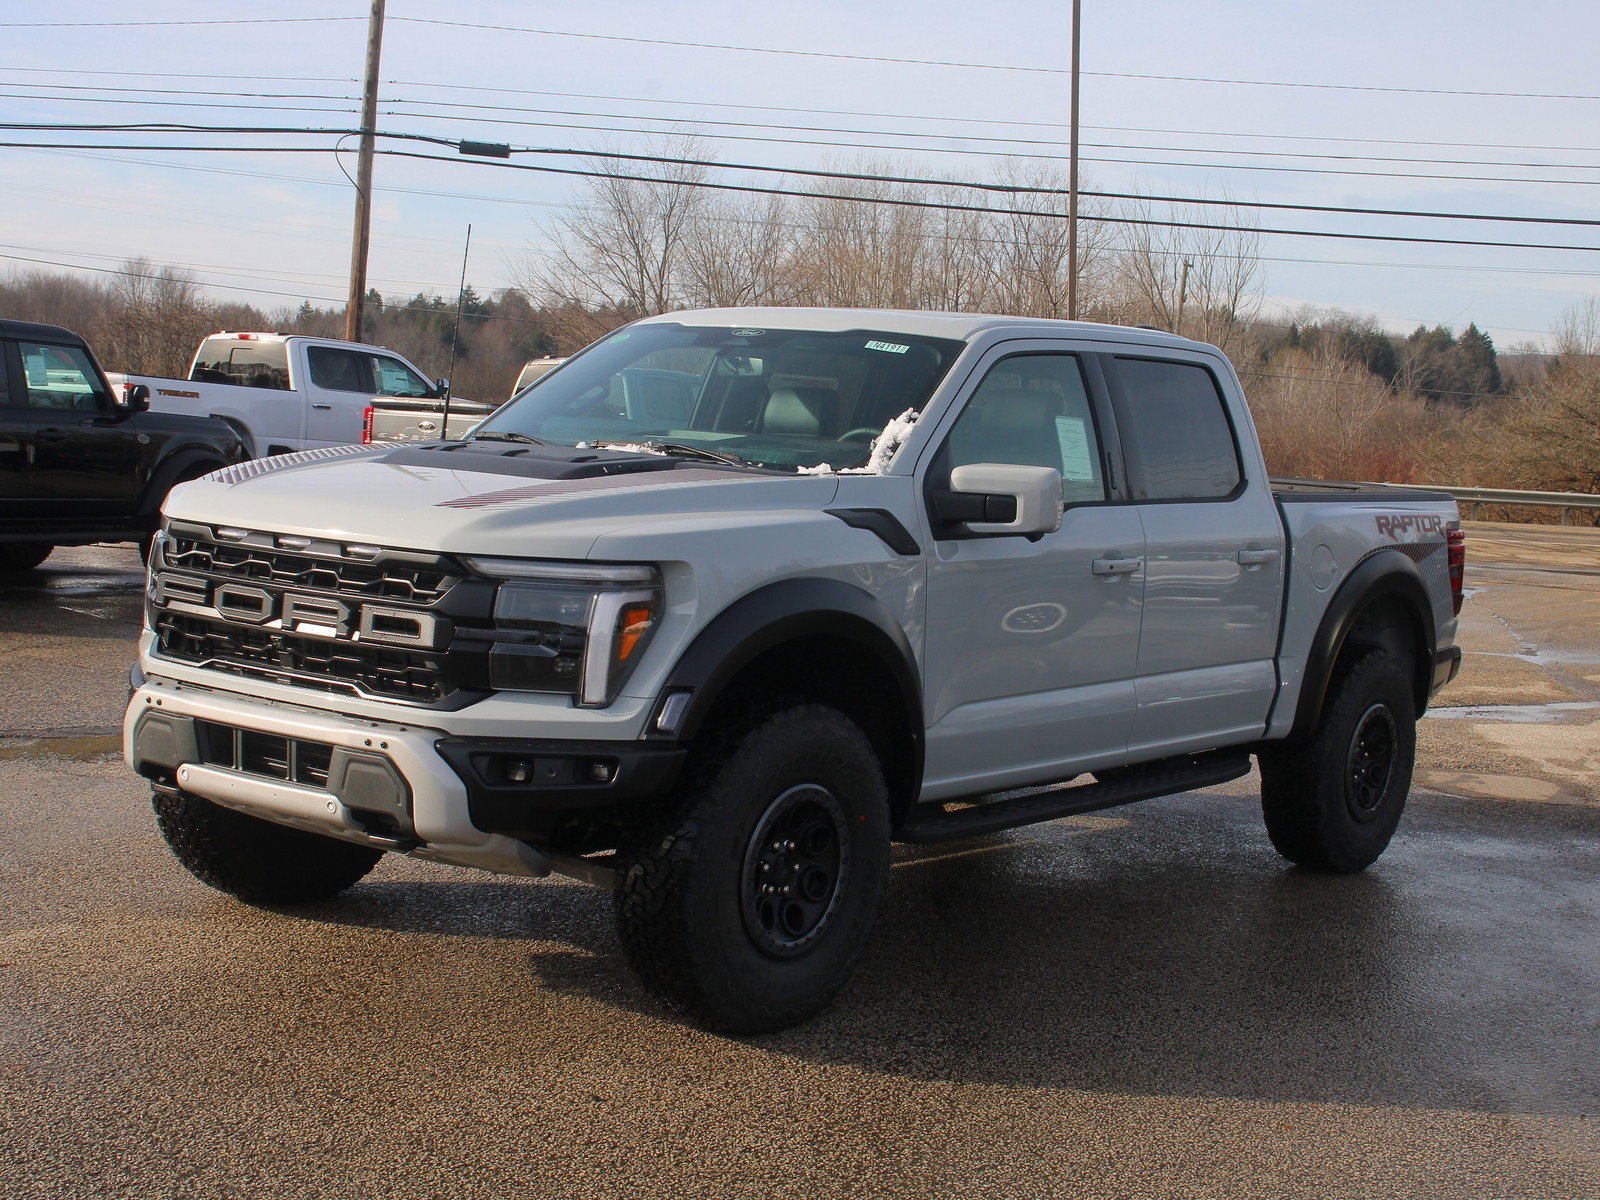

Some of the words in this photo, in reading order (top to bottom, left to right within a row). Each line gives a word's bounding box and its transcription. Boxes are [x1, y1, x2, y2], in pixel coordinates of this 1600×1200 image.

[873, 341, 902, 351] N4191
[1375, 514, 1447, 542] RAPTOR
[155, 571, 436, 648] FORD
